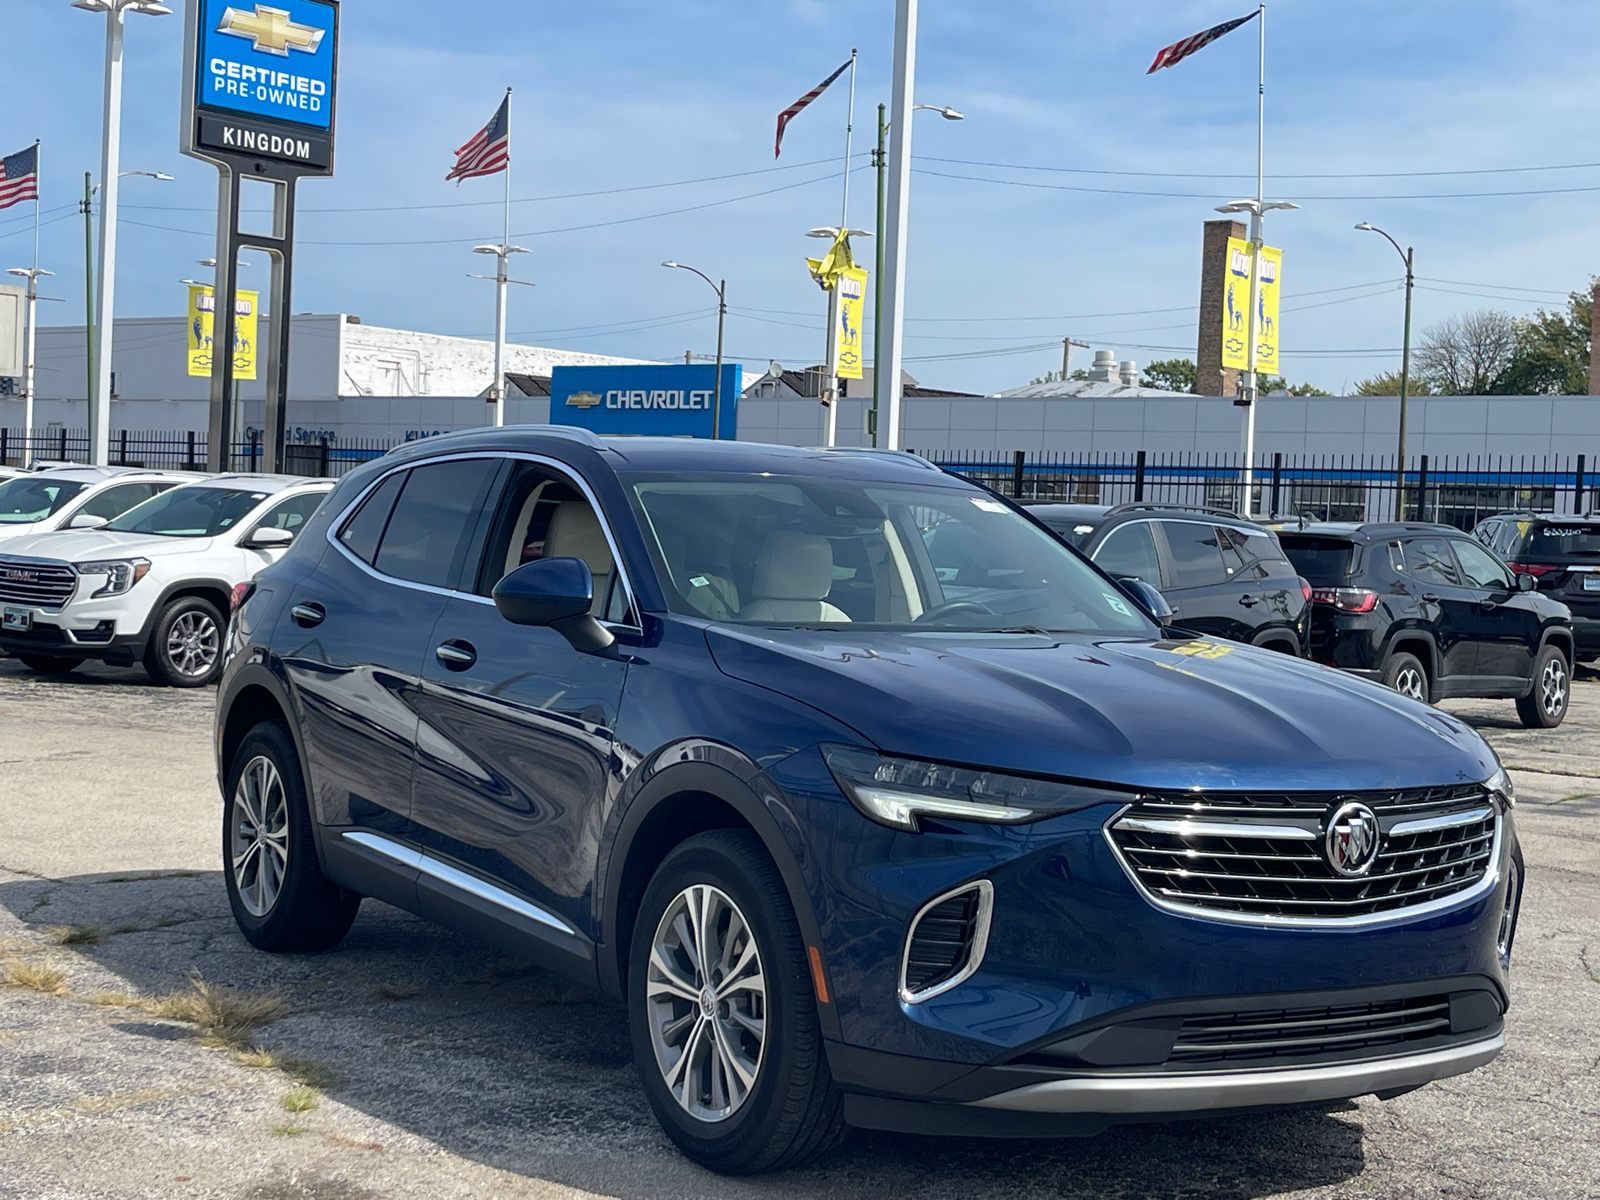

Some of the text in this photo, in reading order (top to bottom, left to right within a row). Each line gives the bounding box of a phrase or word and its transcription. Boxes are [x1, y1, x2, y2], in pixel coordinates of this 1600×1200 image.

[210, 58, 326, 96] CERTIFIED
[214, 77, 321, 112] PRE-OWNED
[223, 126, 310, 159] KINGDOM
[235, 299, 252, 314] om
[606, 390, 715, 409] CHEVROLET
[6, 569, 39, 582] GMC
